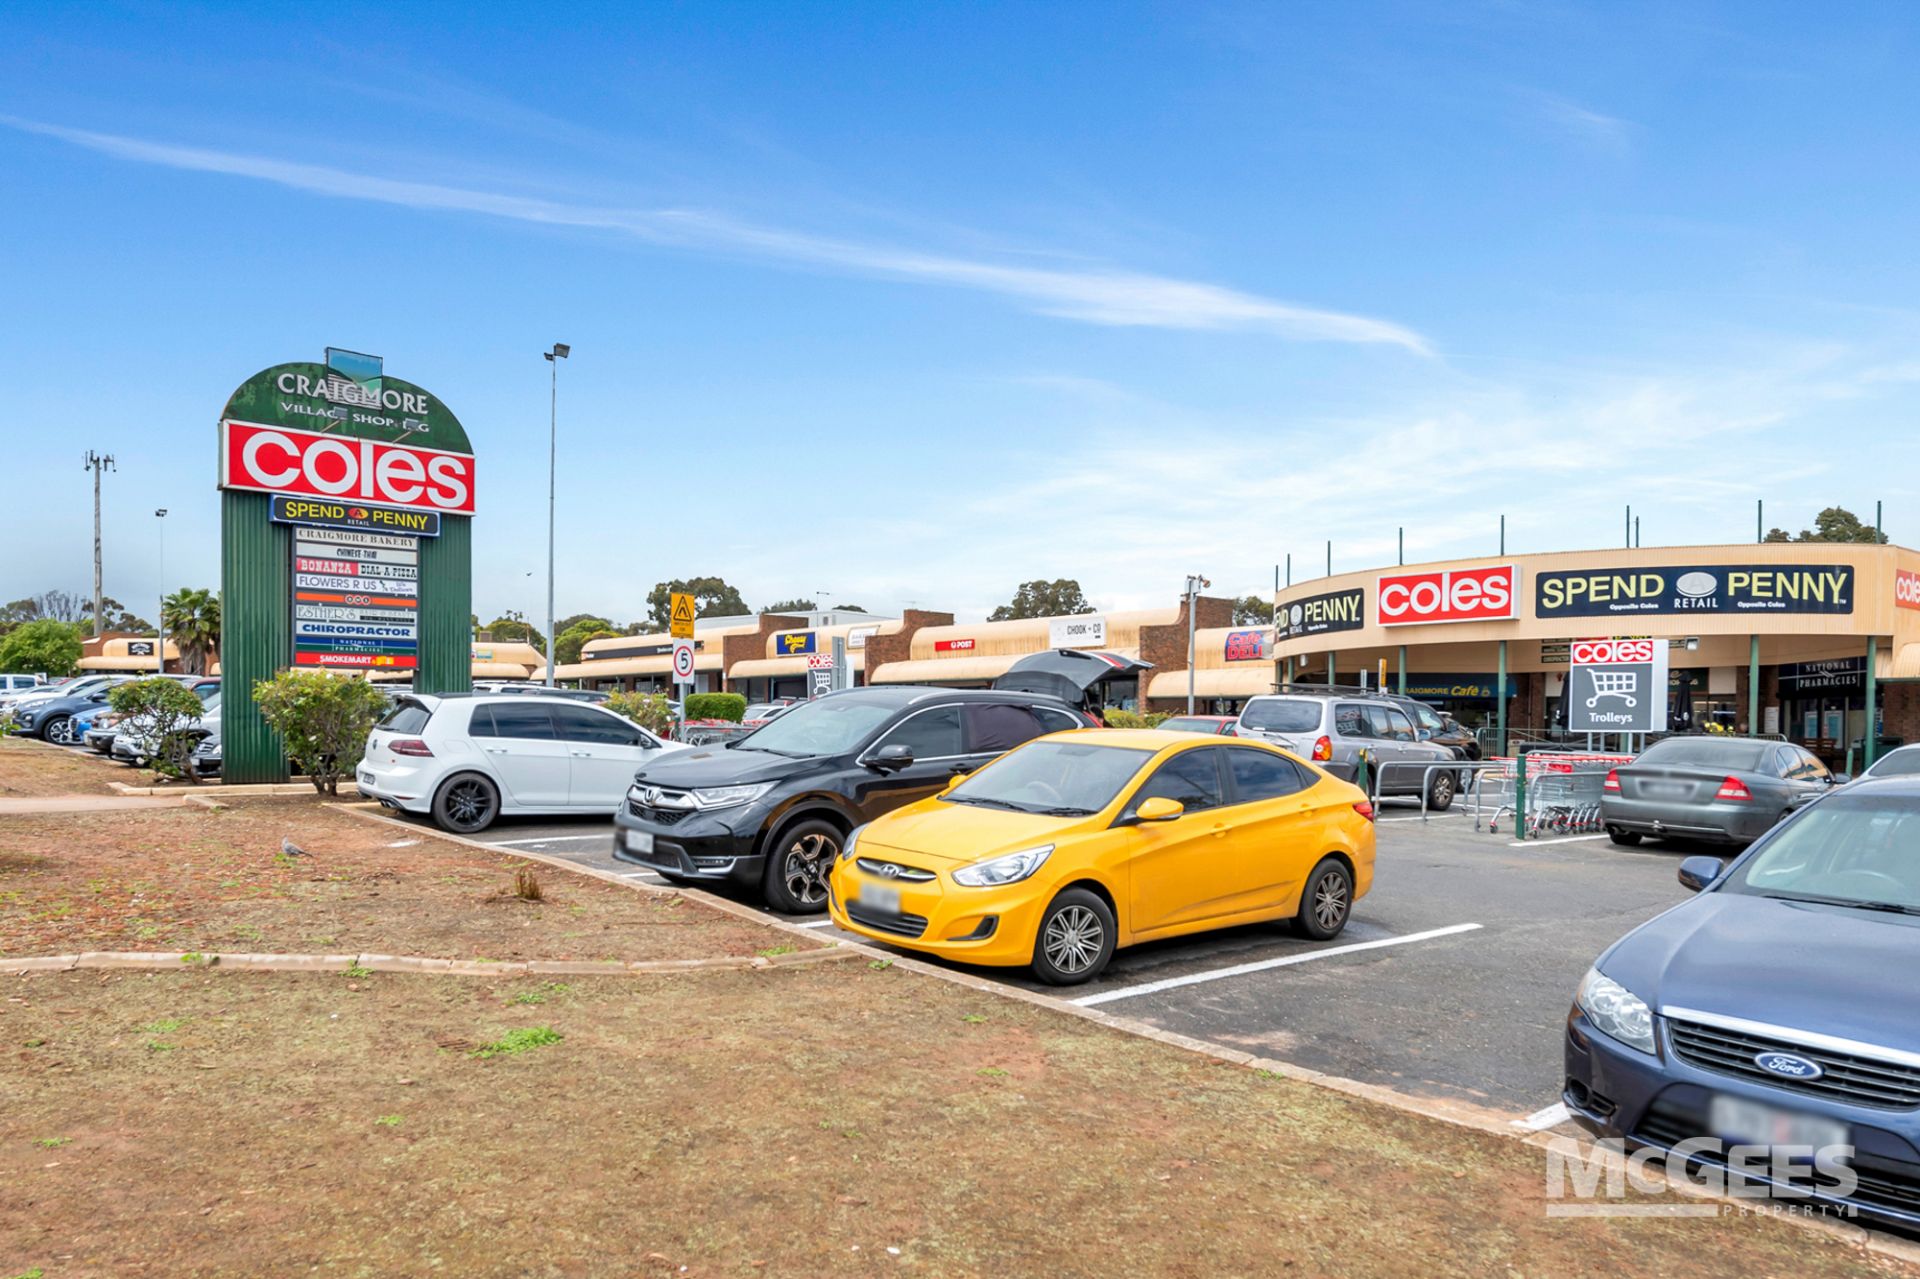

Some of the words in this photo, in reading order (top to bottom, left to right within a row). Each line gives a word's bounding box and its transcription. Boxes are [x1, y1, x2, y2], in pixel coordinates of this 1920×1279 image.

[277, 372, 429, 415] CRAIGMORE
[280, 401, 346, 419] VILLAG
[353, 413, 430, 432] SHOPIG
[242, 431, 468, 508] coles
[285, 502, 345, 519] SPEND
[373, 510, 428, 530] PENNY
[347, 519, 369, 527] RETAIL
[299, 530, 367, 543] CRAIGMORE
[370, 535, 413, 547] BAKERY
[301, 559, 352, 574] BONANZA
[299, 576, 350, 589] FLOWERS
[353, 580, 360, 589] R
[363, 581, 377, 590] US
[1542, 574, 1665, 608] SPEND
[1728, 572, 1847, 604] PENNY
[1896, 574, 1920, 605] cole
[1380, 571, 1509, 616] coles
[1304, 595, 1360, 622] PENNY
[1674, 598, 1718, 608] RETAIL
[302, 624, 410, 636] CHIROPRACTOR
[957, 640, 973, 648] POST
[1227, 644, 1263, 660] DELI
[1574, 640, 1652, 663] coles
[319, 655, 372, 664] SMOKEMART
[681, 652, 689, 670] 5
[1805, 661, 1850, 672] NATIONAL
[1800, 675, 1857, 688] PHARMACIES
[1589, 712, 1633, 725] Trolleys
[1768, 1056, 1805, 1075] Ford
